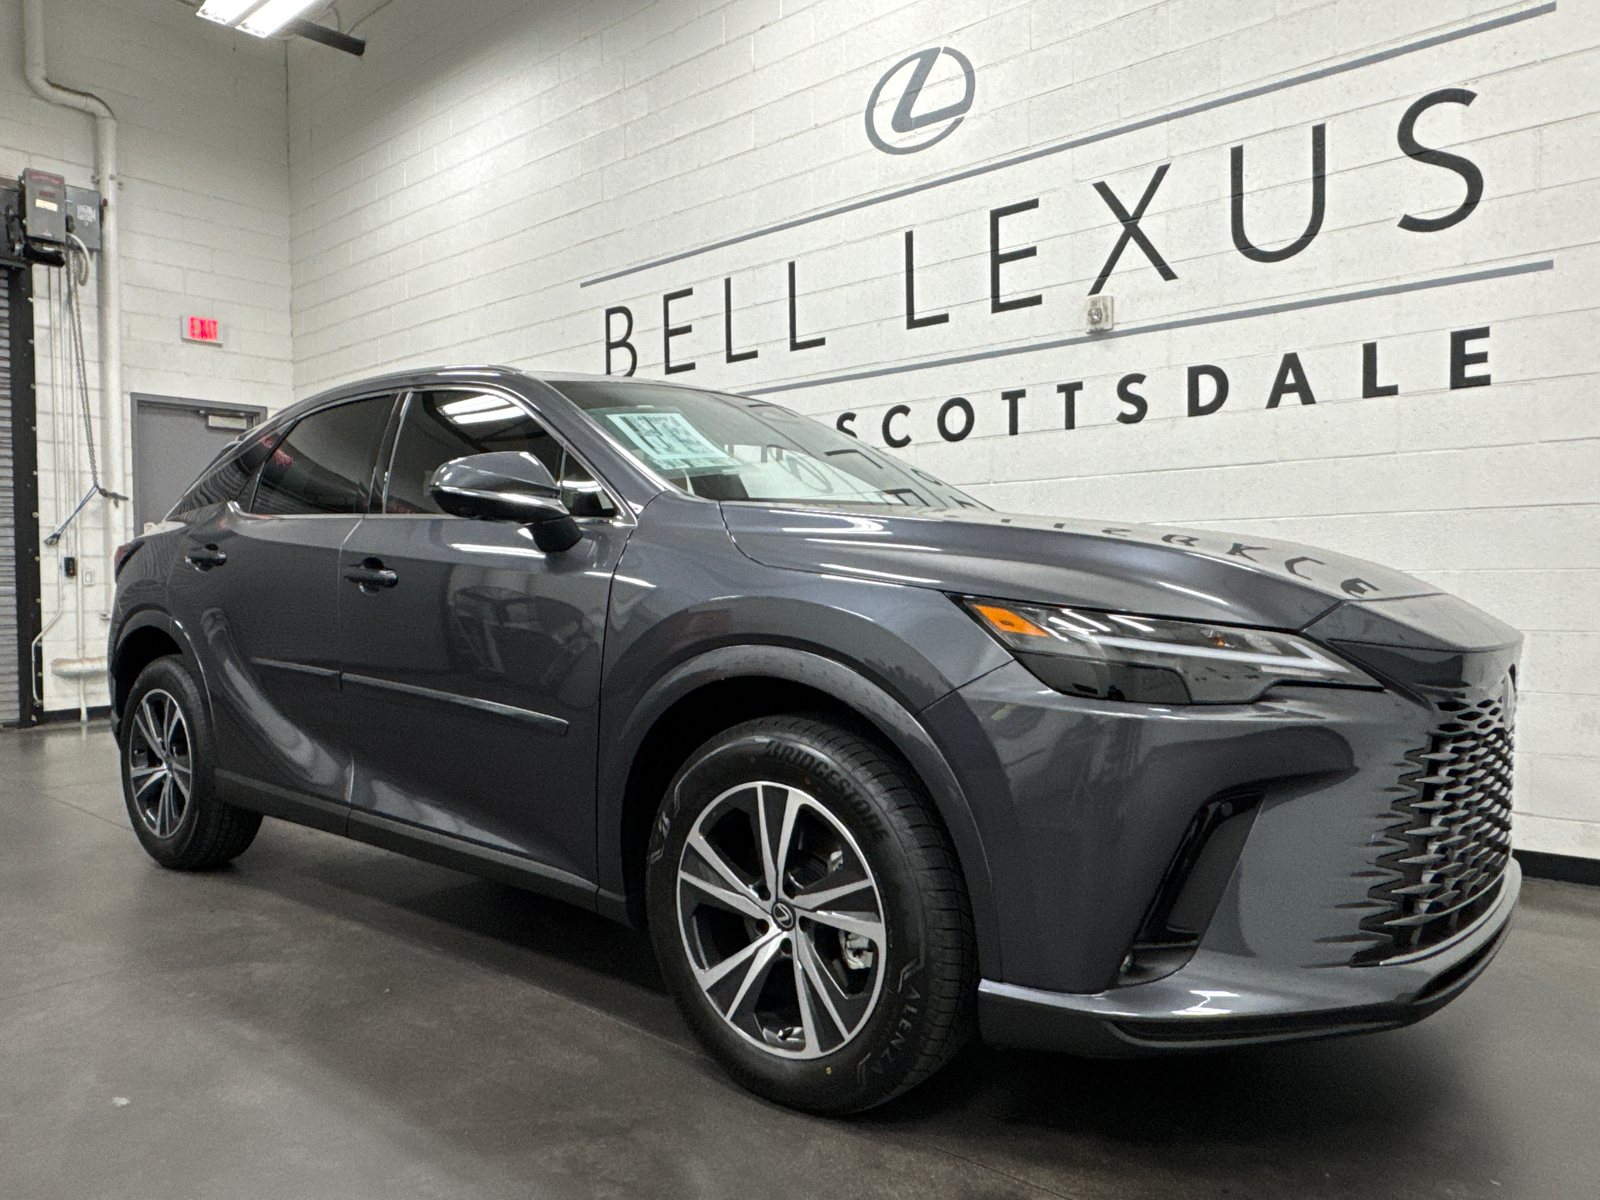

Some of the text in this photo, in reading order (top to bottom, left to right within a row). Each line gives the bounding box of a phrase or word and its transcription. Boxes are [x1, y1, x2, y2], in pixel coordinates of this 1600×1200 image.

[606, 88, 1483, 377] BELL LEXUS
[189, 317, 218, 341] EXIT
[836, 326, 1491, 448] SCOTTSDALE
